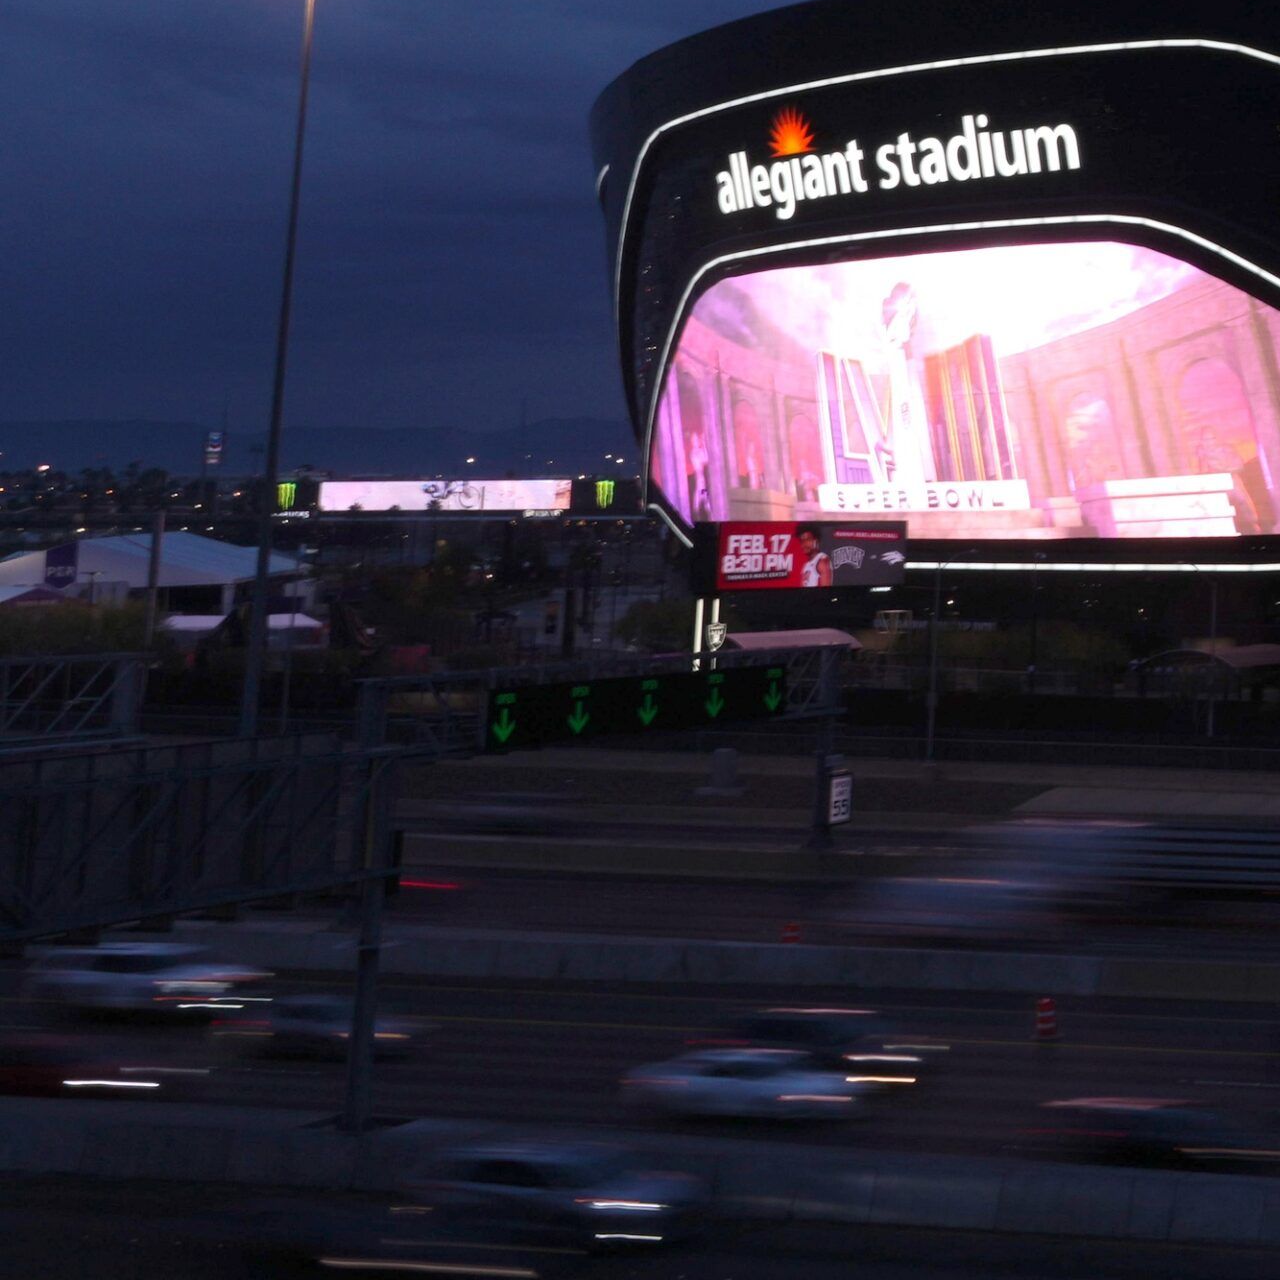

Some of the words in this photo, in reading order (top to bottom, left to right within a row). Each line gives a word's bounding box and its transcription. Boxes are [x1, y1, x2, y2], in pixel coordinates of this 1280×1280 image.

[715, 139, 869, 220] allegiant
[875, 113, 1082, 190] stadium
[926, 488, 1005, 509] BOWL
[727, 534, 768, 554] FEB.
[770, 534, 792, 553] 17
[722, 554, 763, 574] 8:30
[764, 553, 794, 572] PM
[833, 799, 849, 817] 55
